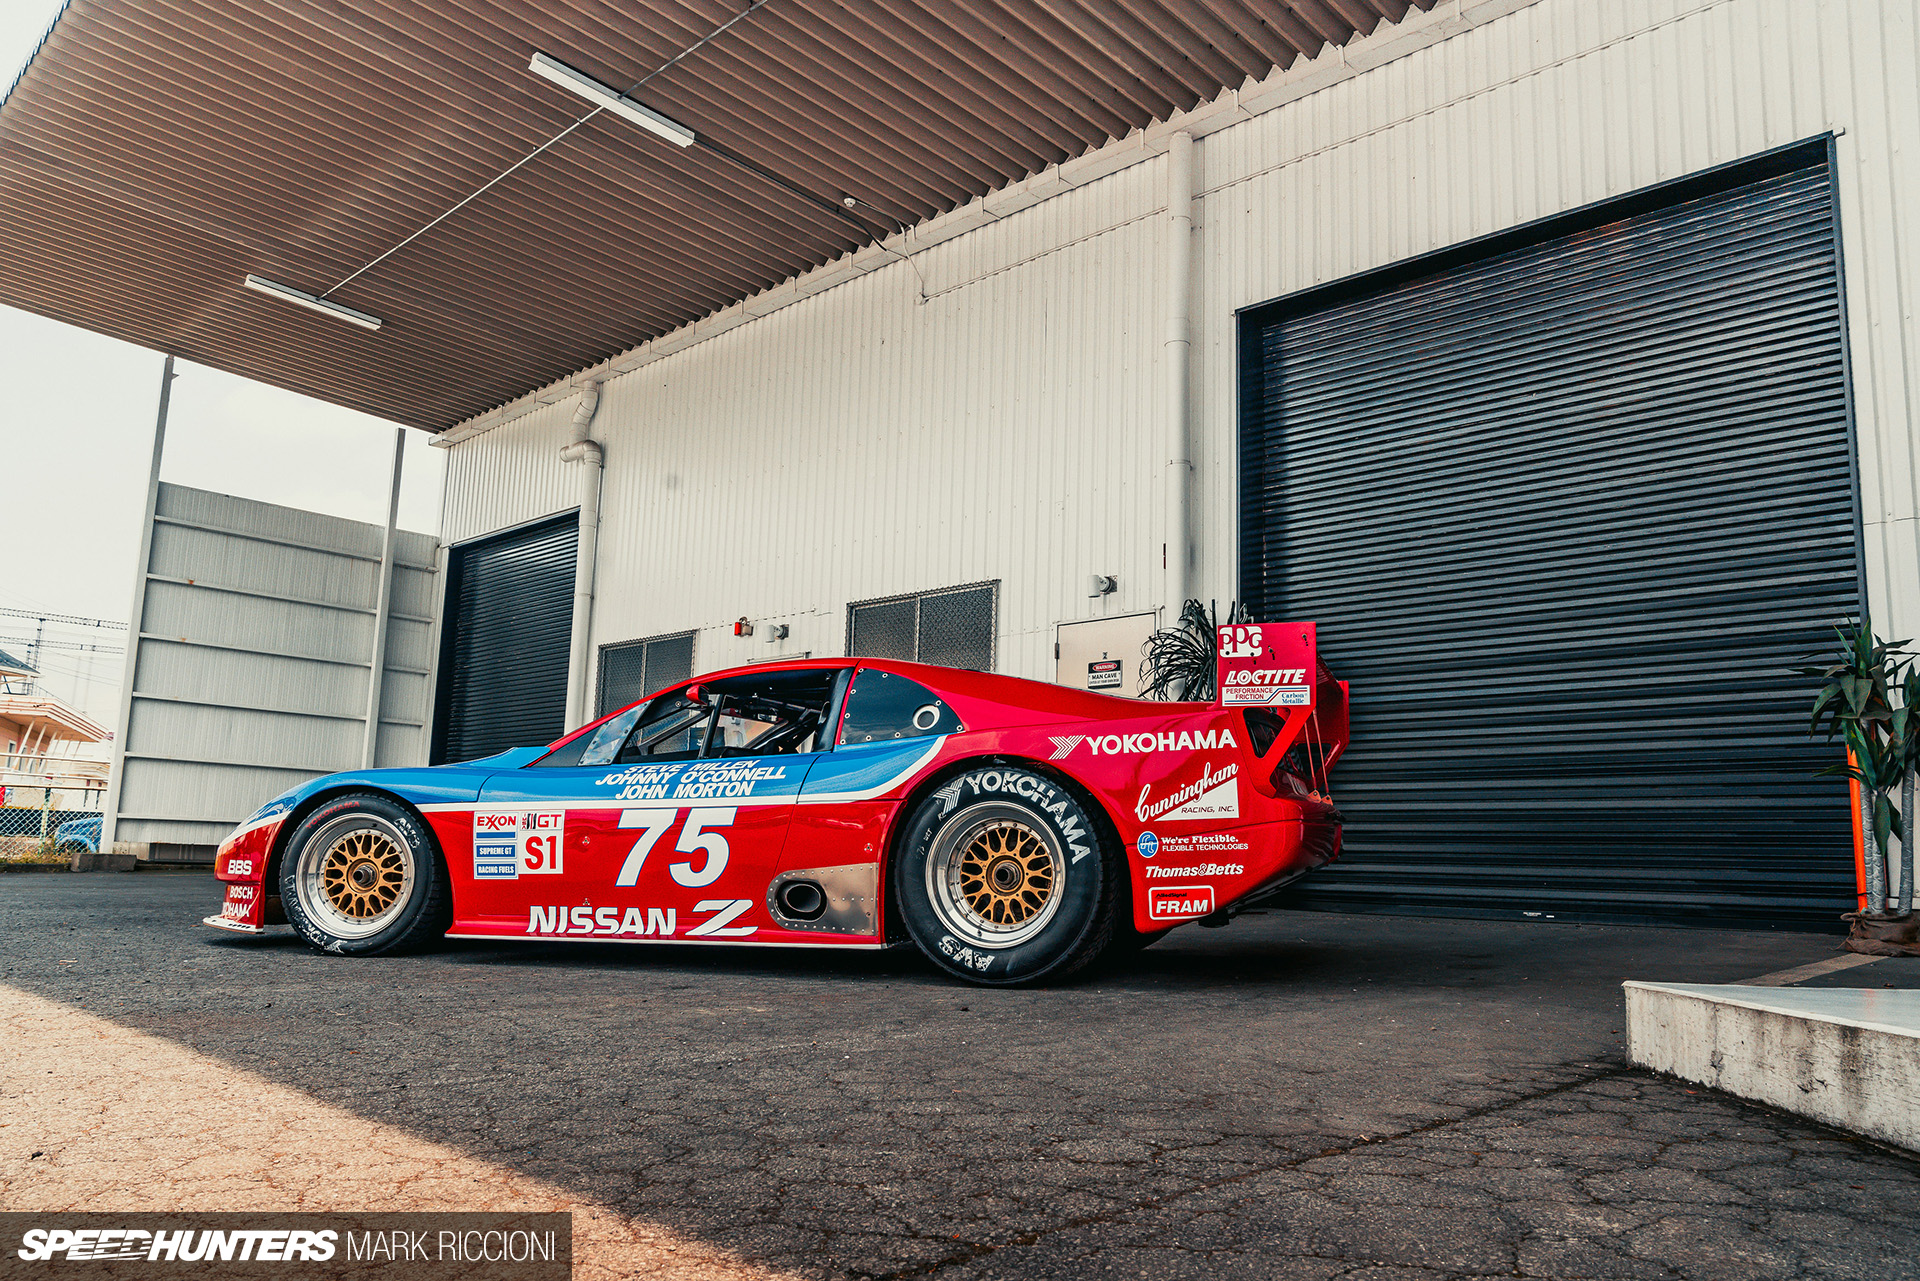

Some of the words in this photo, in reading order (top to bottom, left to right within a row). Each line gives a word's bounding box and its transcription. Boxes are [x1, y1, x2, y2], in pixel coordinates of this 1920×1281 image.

[1220, 627, 1262, 654] PPG
[1224, 669, 1307, 685] LOCTITE
[1085, 729, 1237, 755] YOKOHAMA
[624, 763, 688, 774] STEVE
[688, 759, 761, 772] MILLEN
[595, 771, 679, 786] JOHNNY
[680, 766, 787, 784] O'CONNELL
[615, 784, 669, 800] JOHN
[672, 780, 756, 799] MORTON
[1134, 761, 1239, 822] Cunningham
[306, 801, 360, 829] YOKOHAMA
[477, 814, 517, 831] EXXON
[537, 814, 562, 828] GT
[966, 771, 1091, 865] YOKOHAMA
[615, 806, 738, 888] 75
[1161, 836, 1189, 844] We're
[1192, 834, 1239, 843] Flexible.
[1195, 843, 1249, 851] TECHNOLOGIES
[479, 847, 504, 855] SUPREME
[505, 847, 513, 855] GT
[524, 835, 557, 870] S1
[227, 859, 252, 875] BBS
[478, 865, 498, 874] RACING
[498, 865, 515, 874] FUELS
[1145, 863, 1244, 878] Thomas&Betts
[229, 885, 254, 899] BOSCH
[284, 875, 328, 945] YOKAMA
[1156, 899, 1209, 914] FRAM
[526, 905, 677, 936] NISSAN
[939, 935, 996, 972] AVS
